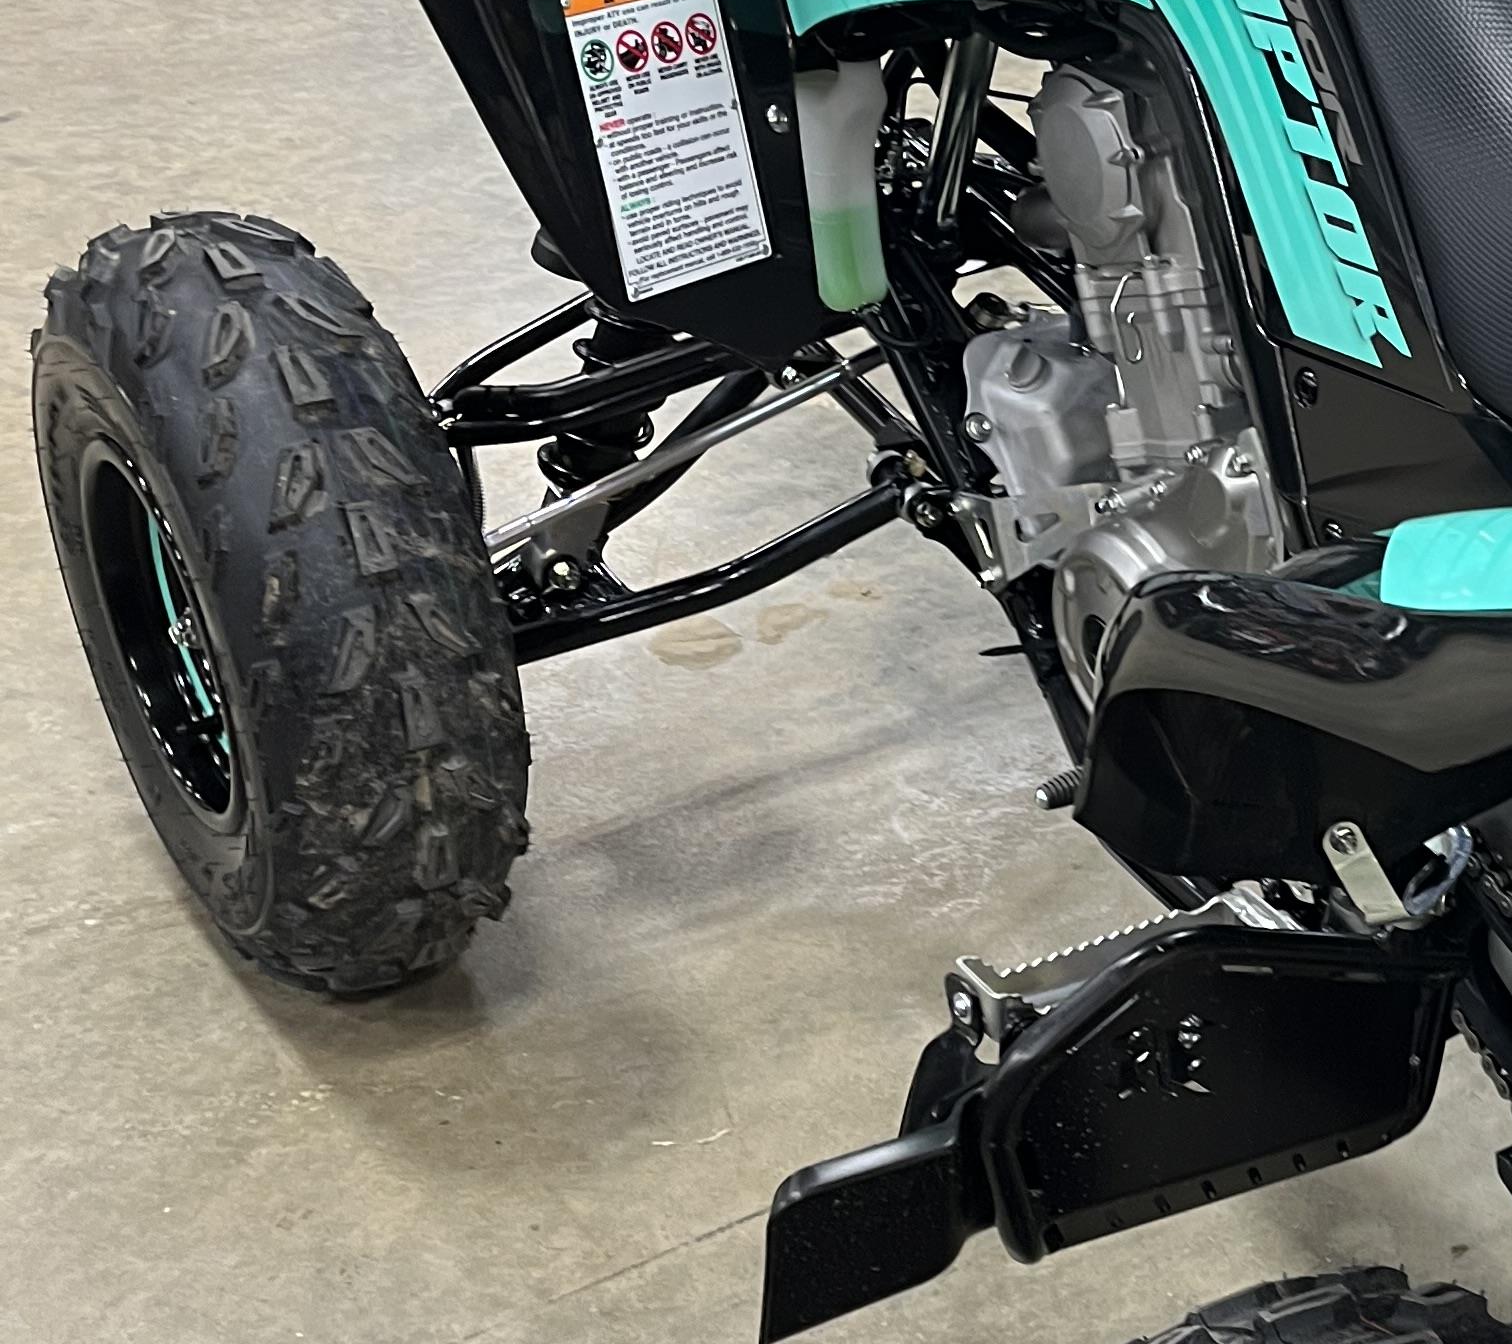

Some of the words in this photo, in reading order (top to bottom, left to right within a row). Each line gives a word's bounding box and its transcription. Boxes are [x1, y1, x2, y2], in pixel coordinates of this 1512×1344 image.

[572, 15, 604, 27] Improper
[607, 10, 620, 18] ATV
[574, 25, 601, 37] INJURY
[599, 118, 625, 131] NEVER
